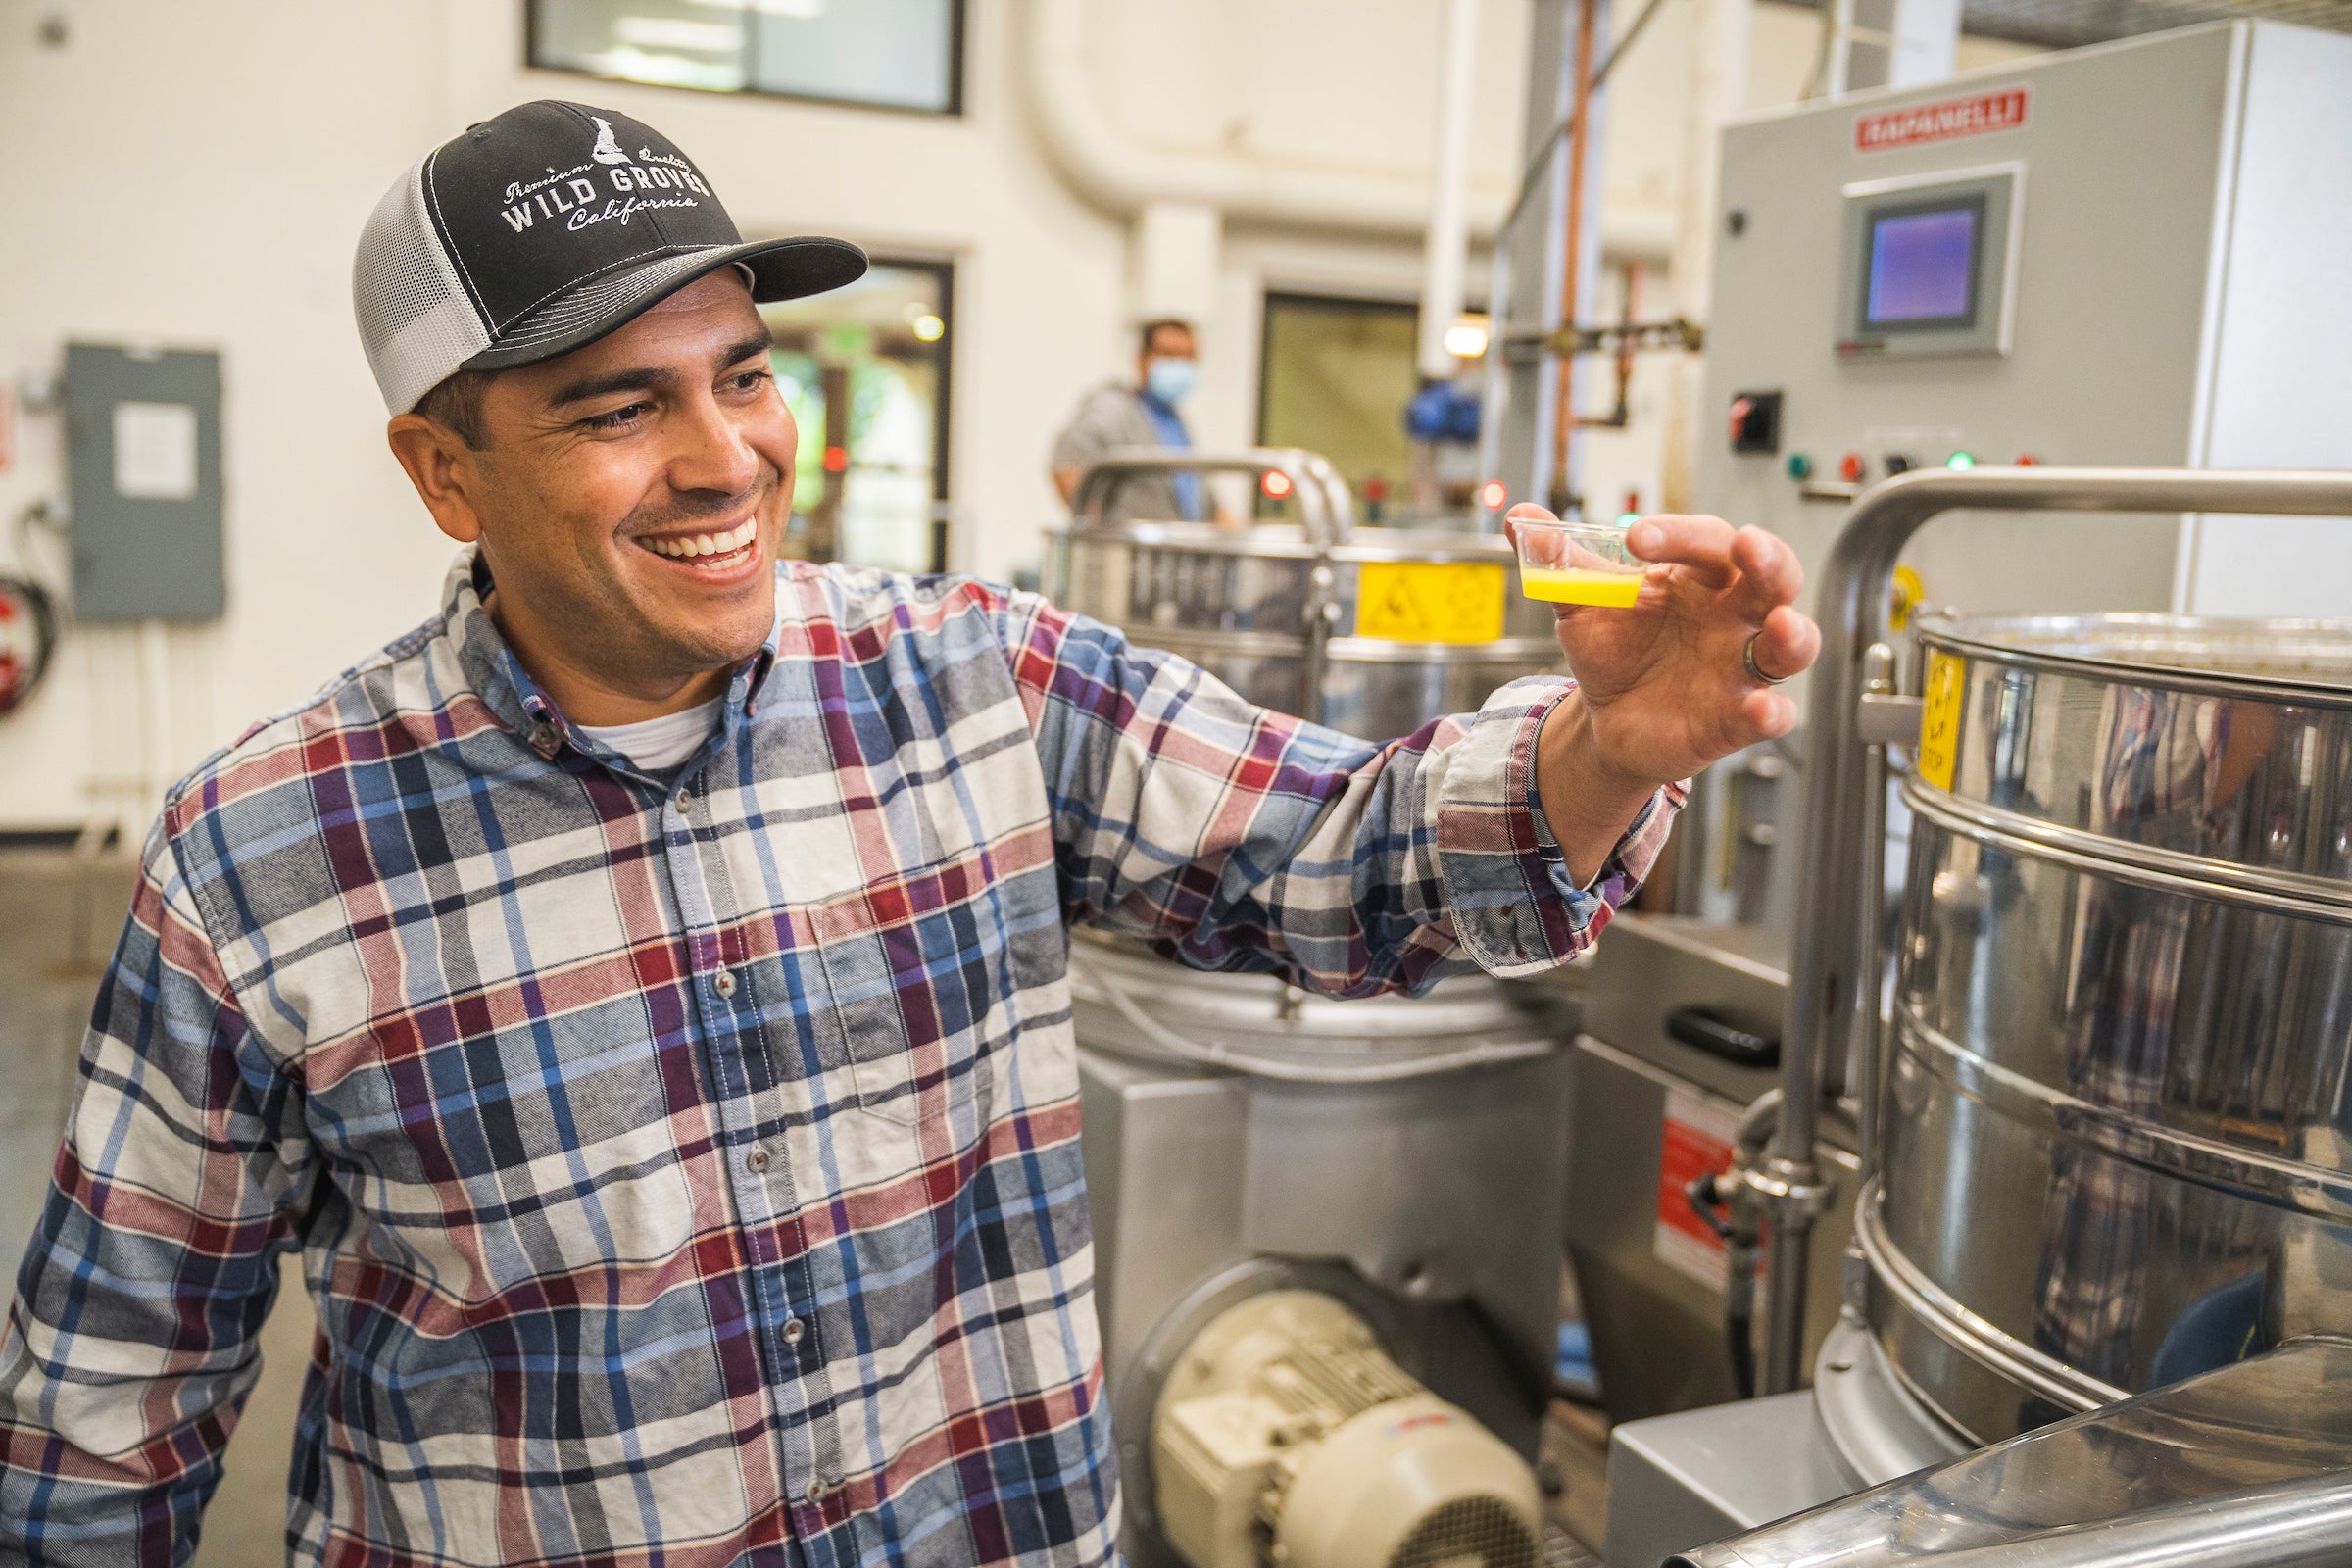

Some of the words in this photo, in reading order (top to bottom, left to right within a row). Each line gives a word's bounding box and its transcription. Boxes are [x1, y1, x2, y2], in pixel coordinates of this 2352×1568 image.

[501, 178, 597, 233] WILD
[609, 166, 710, 197] GROVES
[503, 163, 594, 205] Premium
[566, 191, 699, 231] California
